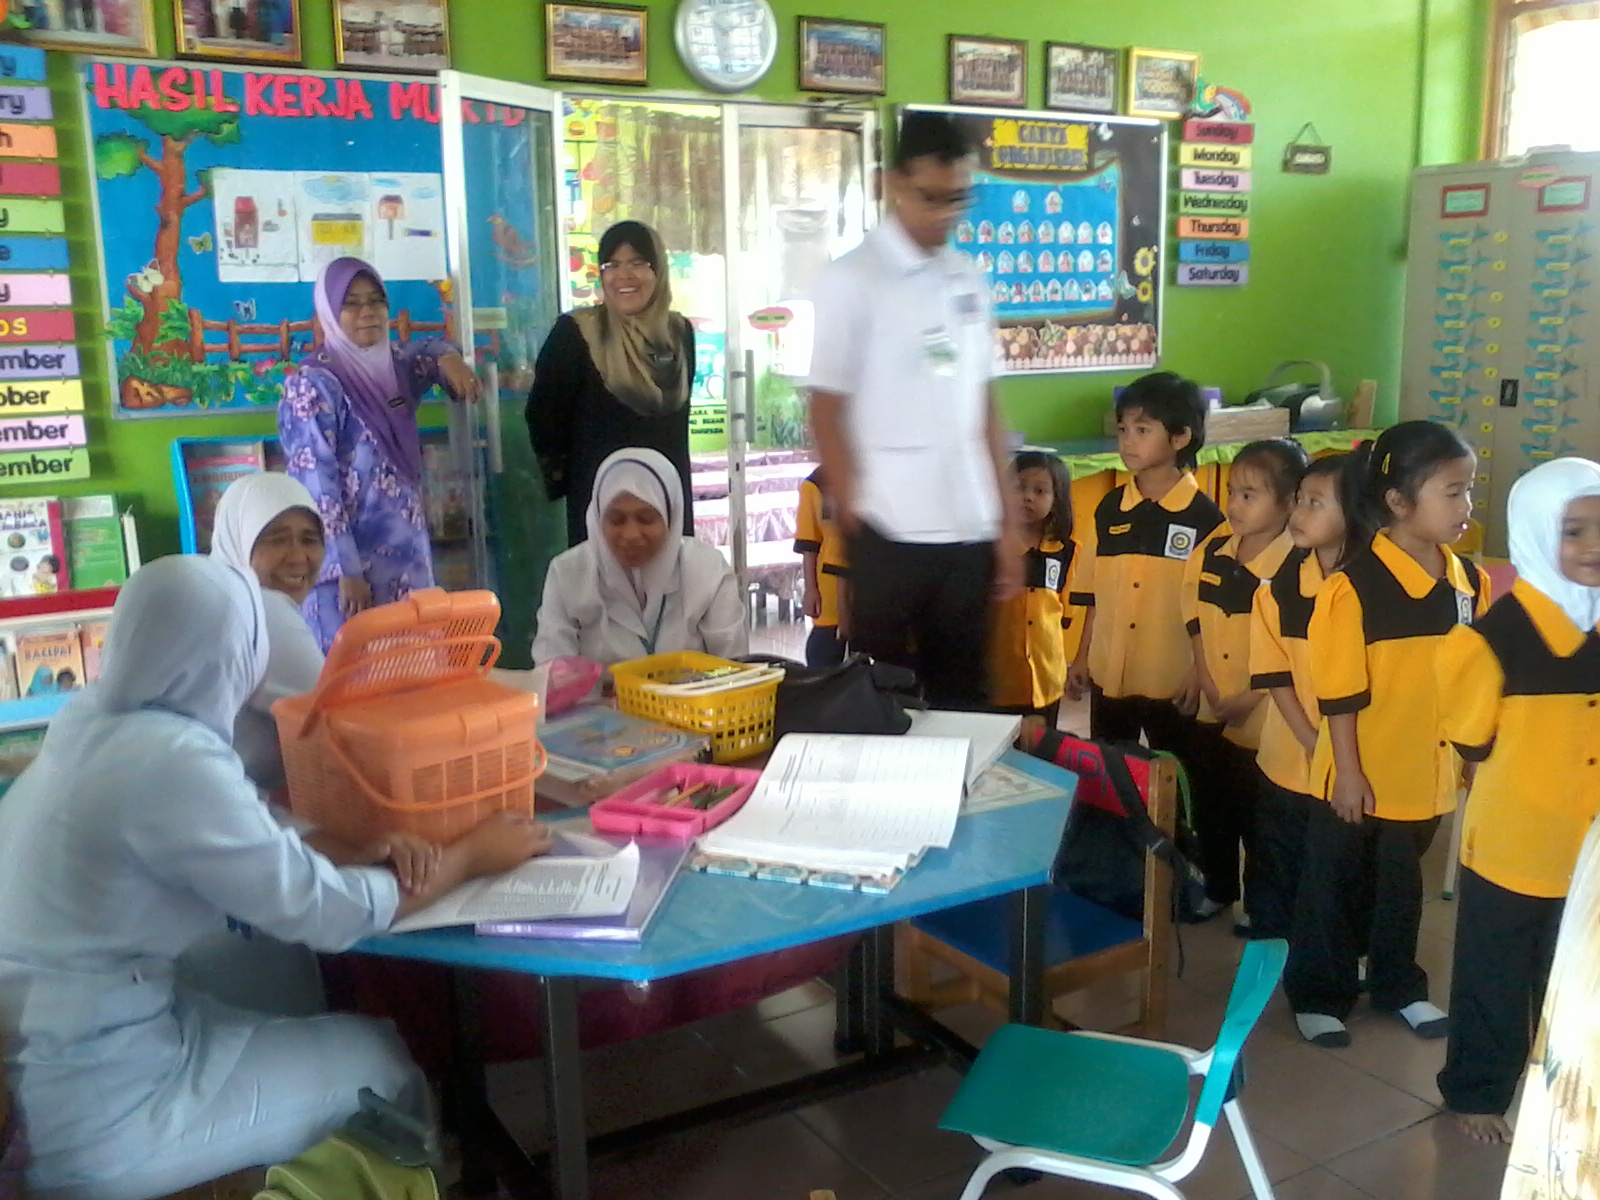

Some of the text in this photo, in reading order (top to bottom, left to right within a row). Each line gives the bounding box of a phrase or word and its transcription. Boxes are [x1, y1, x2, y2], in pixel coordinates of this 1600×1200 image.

[94, 63, 239, 113] HASIL
[244, 72, 373, 120] KERJA
[1193, 147, 1241, 166] Monday
[1194, 170, 1239, 188] Tuesday
[1183, 193, 1248, 213] Wednesday
[1190, 218, 1242, 236] Thursday
[1194, 241, 1230, 259] Friday
[1188, 264, 1240, 283] Saturday
